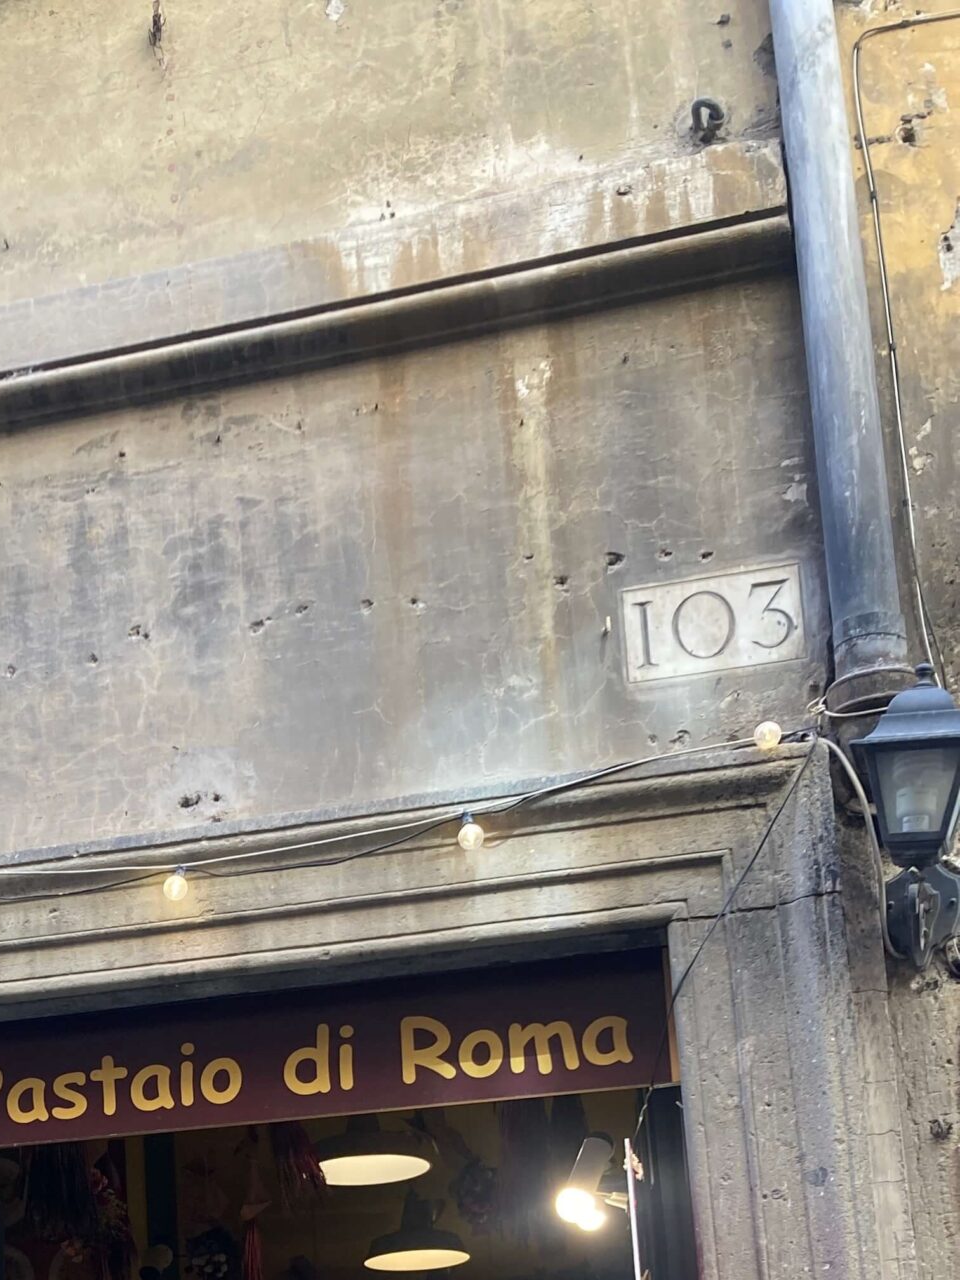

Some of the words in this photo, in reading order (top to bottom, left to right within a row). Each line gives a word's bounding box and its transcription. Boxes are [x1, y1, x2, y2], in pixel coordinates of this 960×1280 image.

[632, 577, 796, 669] 103
[283, 1024, 354, 1095] di
[400, 1015, 633, 1085] Roma
